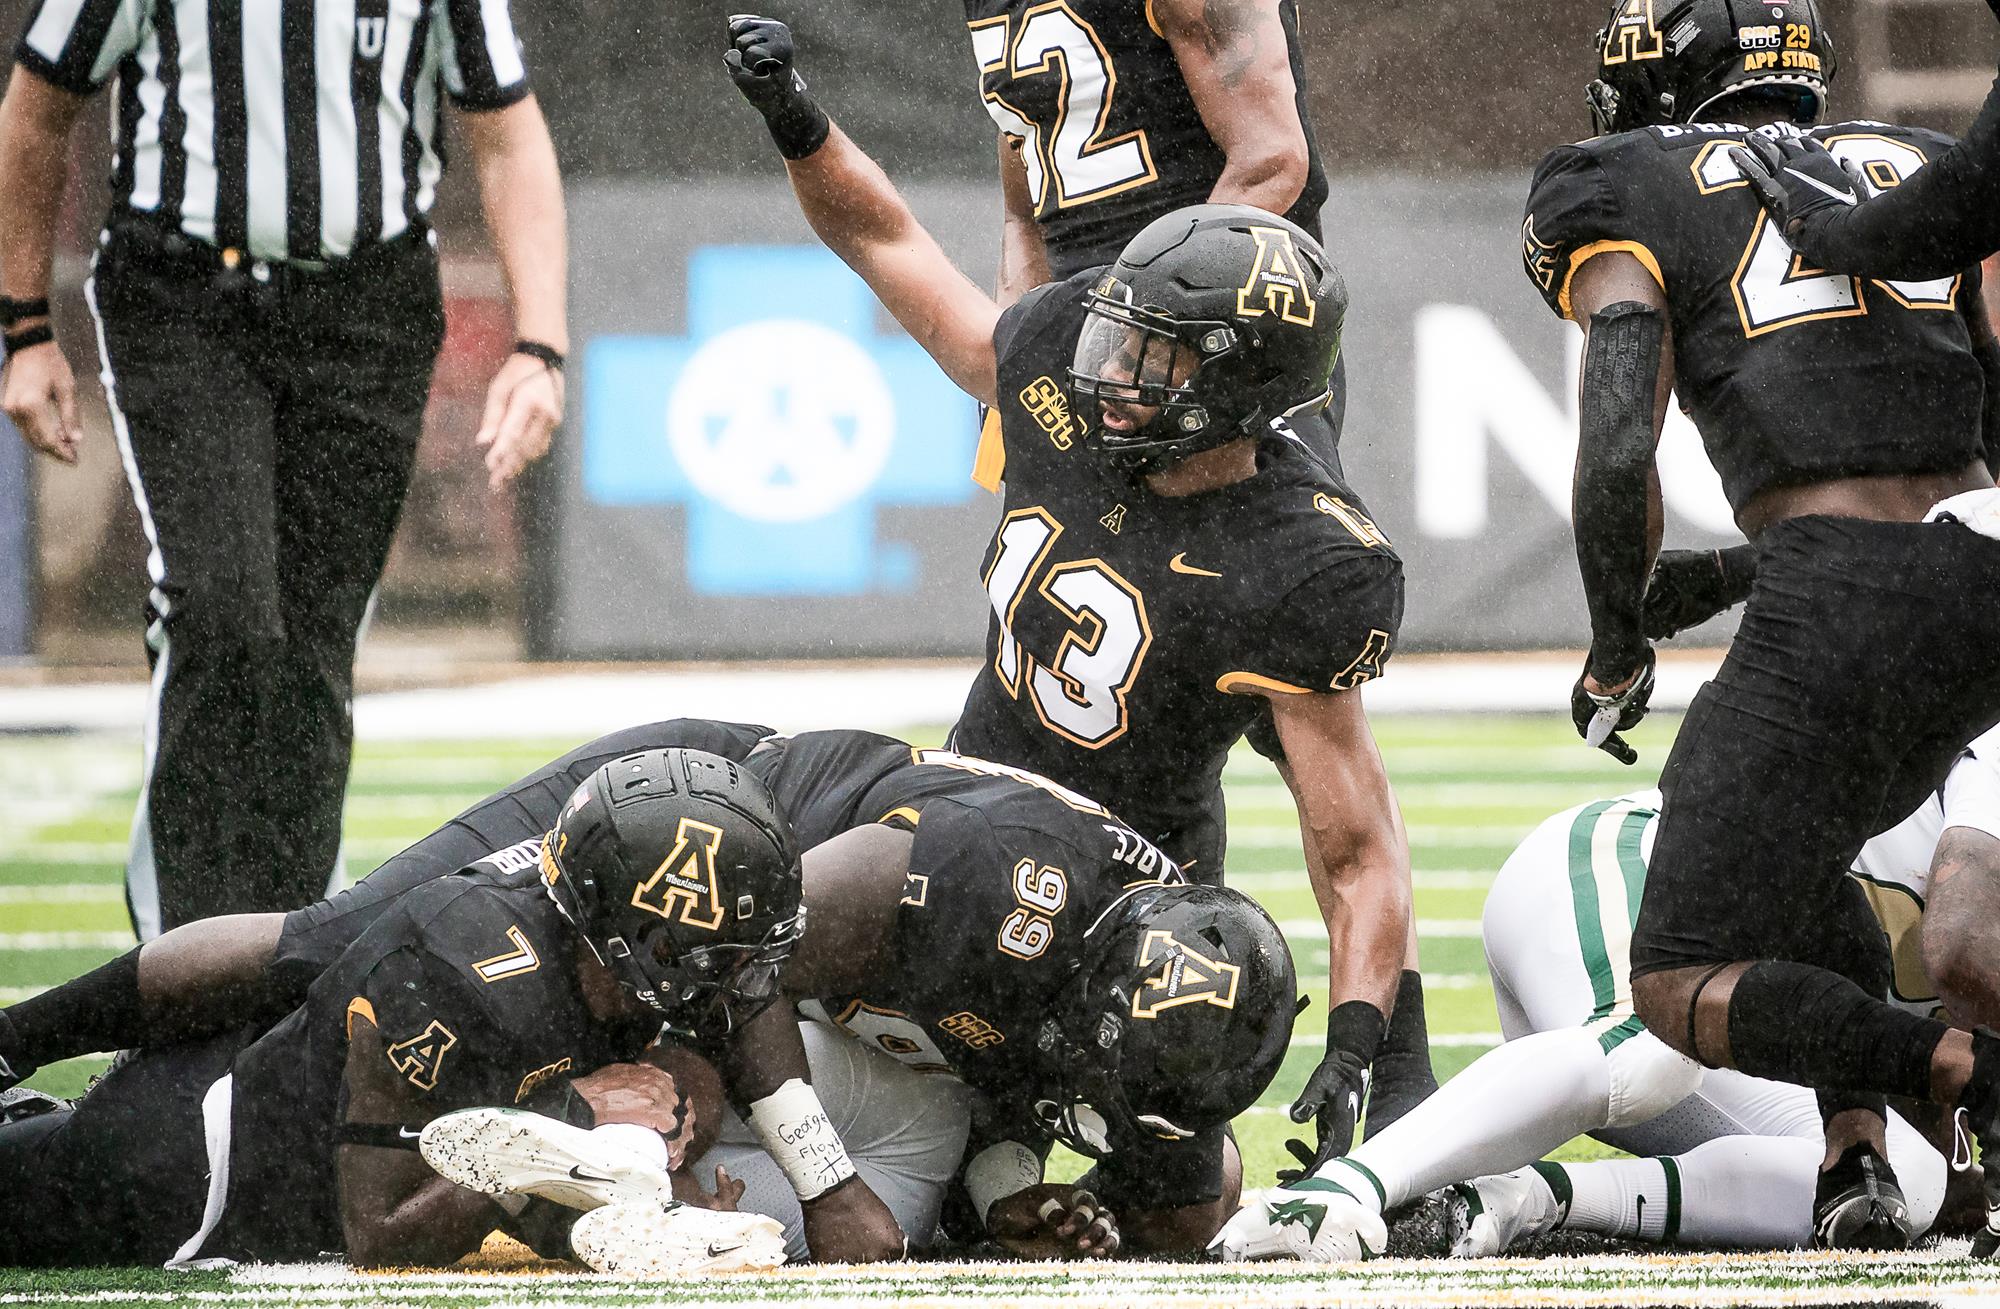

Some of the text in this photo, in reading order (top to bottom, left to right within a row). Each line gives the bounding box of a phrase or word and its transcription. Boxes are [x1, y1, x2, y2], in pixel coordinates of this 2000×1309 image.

[356, 16, 386, 58] U
[1743, 51, 1821, 72] APP STATE
[1785, 23, 1810, 49] 29
[967, 0, 1159, 218] 52
[1236, 226, 1316, 328] A
[1100, 503, 1127, 534] A
[982, 505, 1153, 750] 13
[631, 817, 725, 931] A
[471, 925, 541, 983] 7
[1132, 929, 1241, 1019] A
[387, 1019, 457, 1091] A
